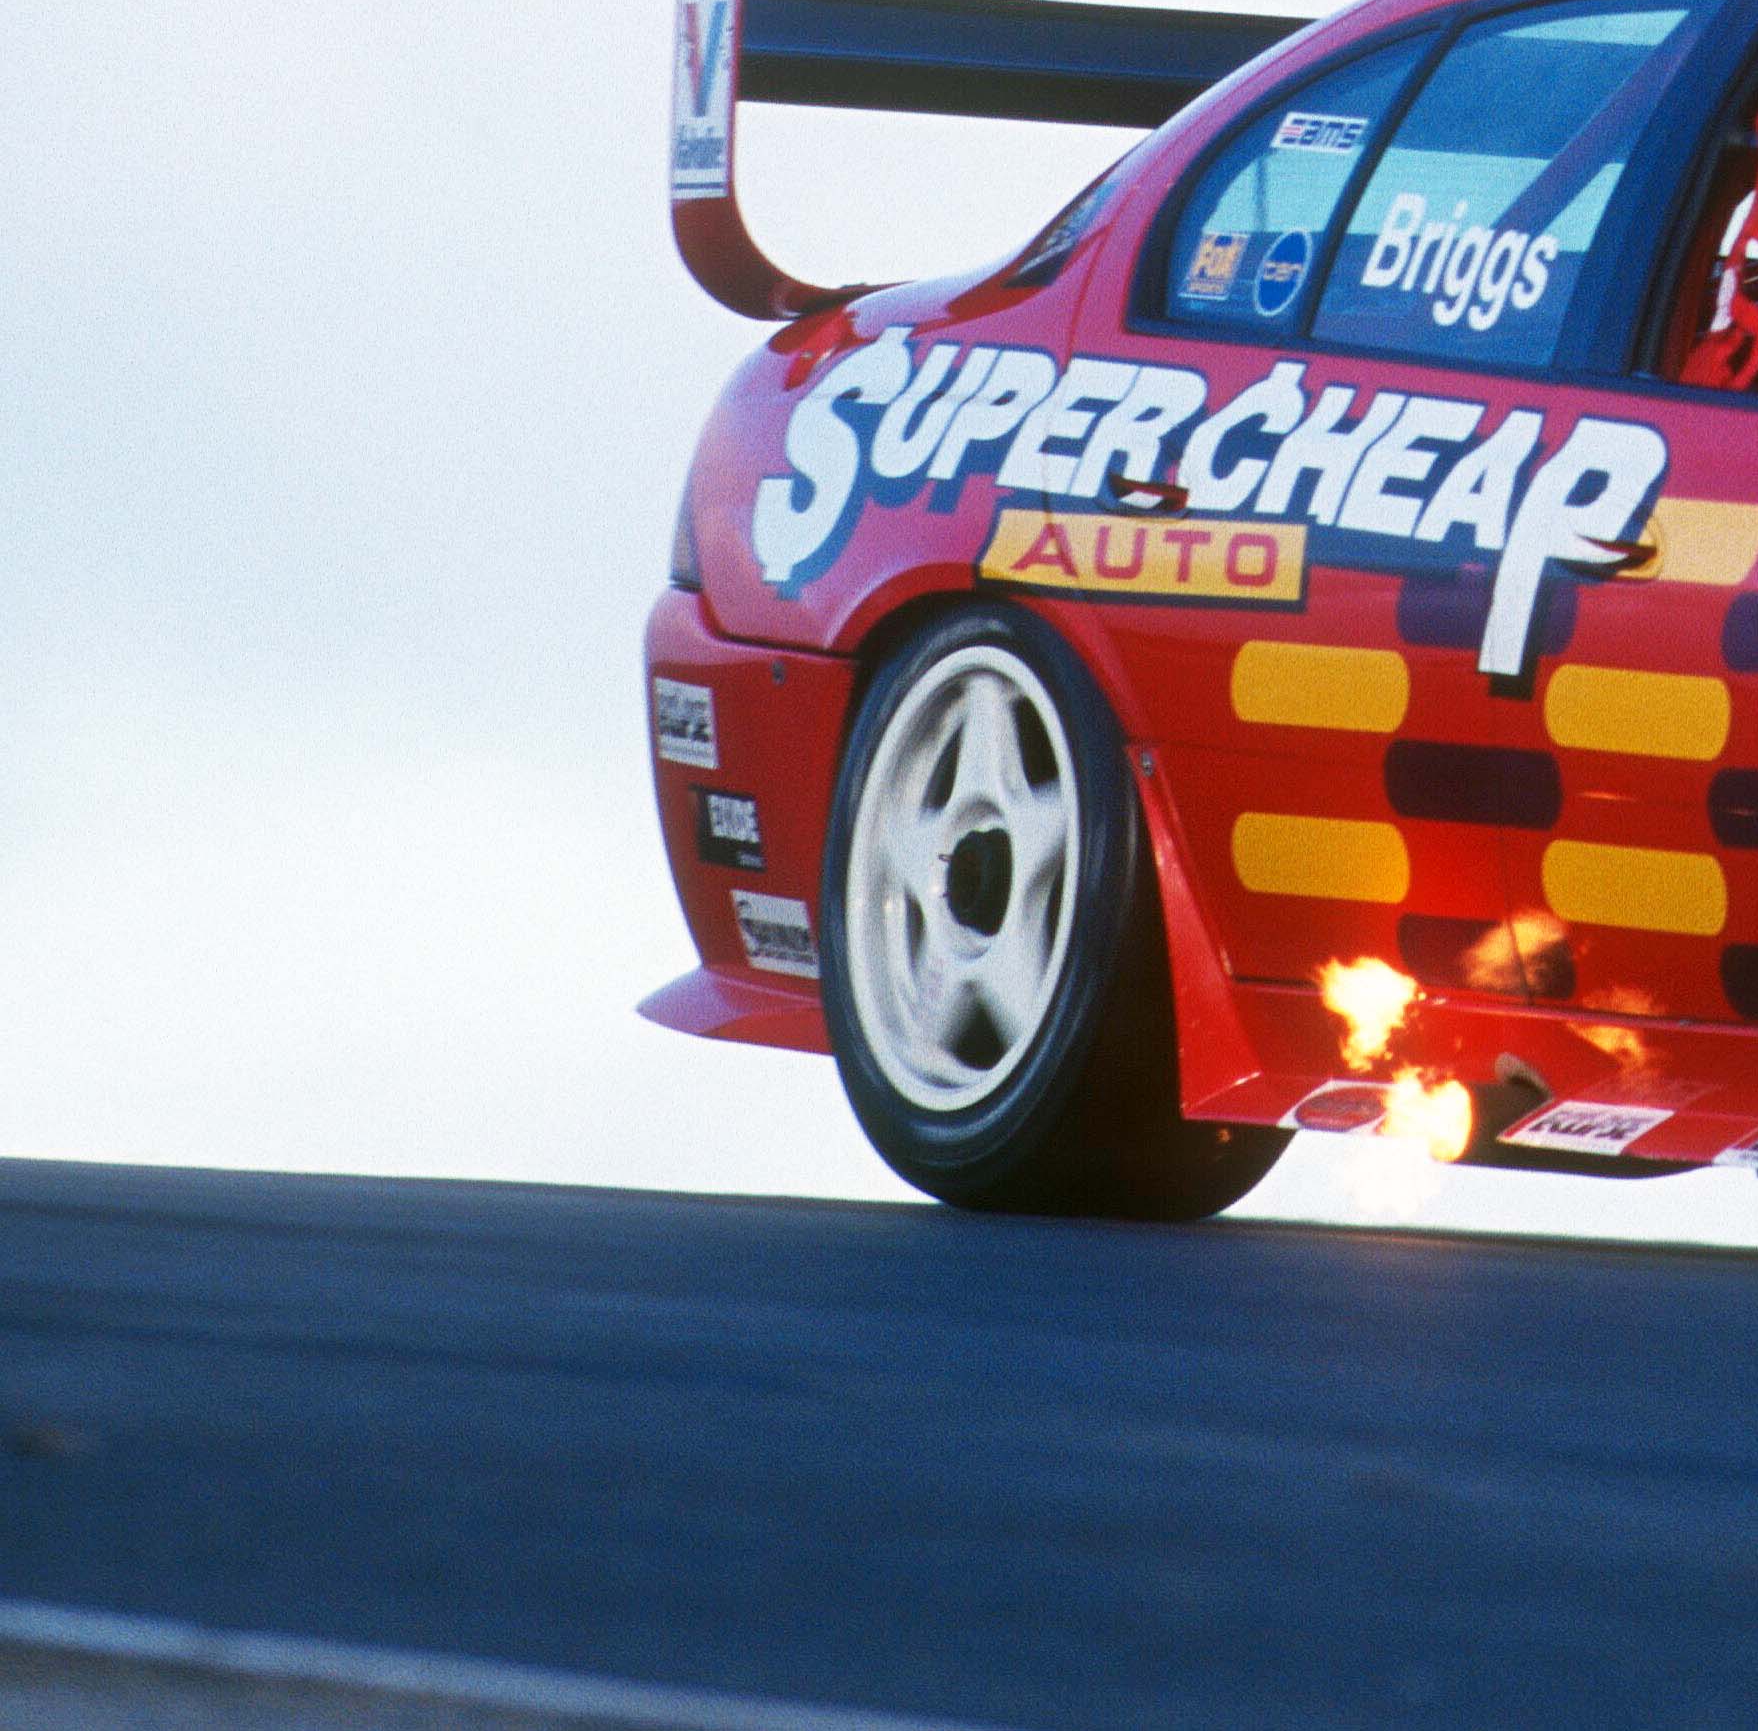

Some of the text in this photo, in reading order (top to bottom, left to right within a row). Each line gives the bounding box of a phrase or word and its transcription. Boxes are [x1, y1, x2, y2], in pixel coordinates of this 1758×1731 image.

[1362, 193, 1560, 331] Briggs
[752, 325, 1668, 676] SUPER CHEAP
[1011, 524, 1278, 588] AUTO
